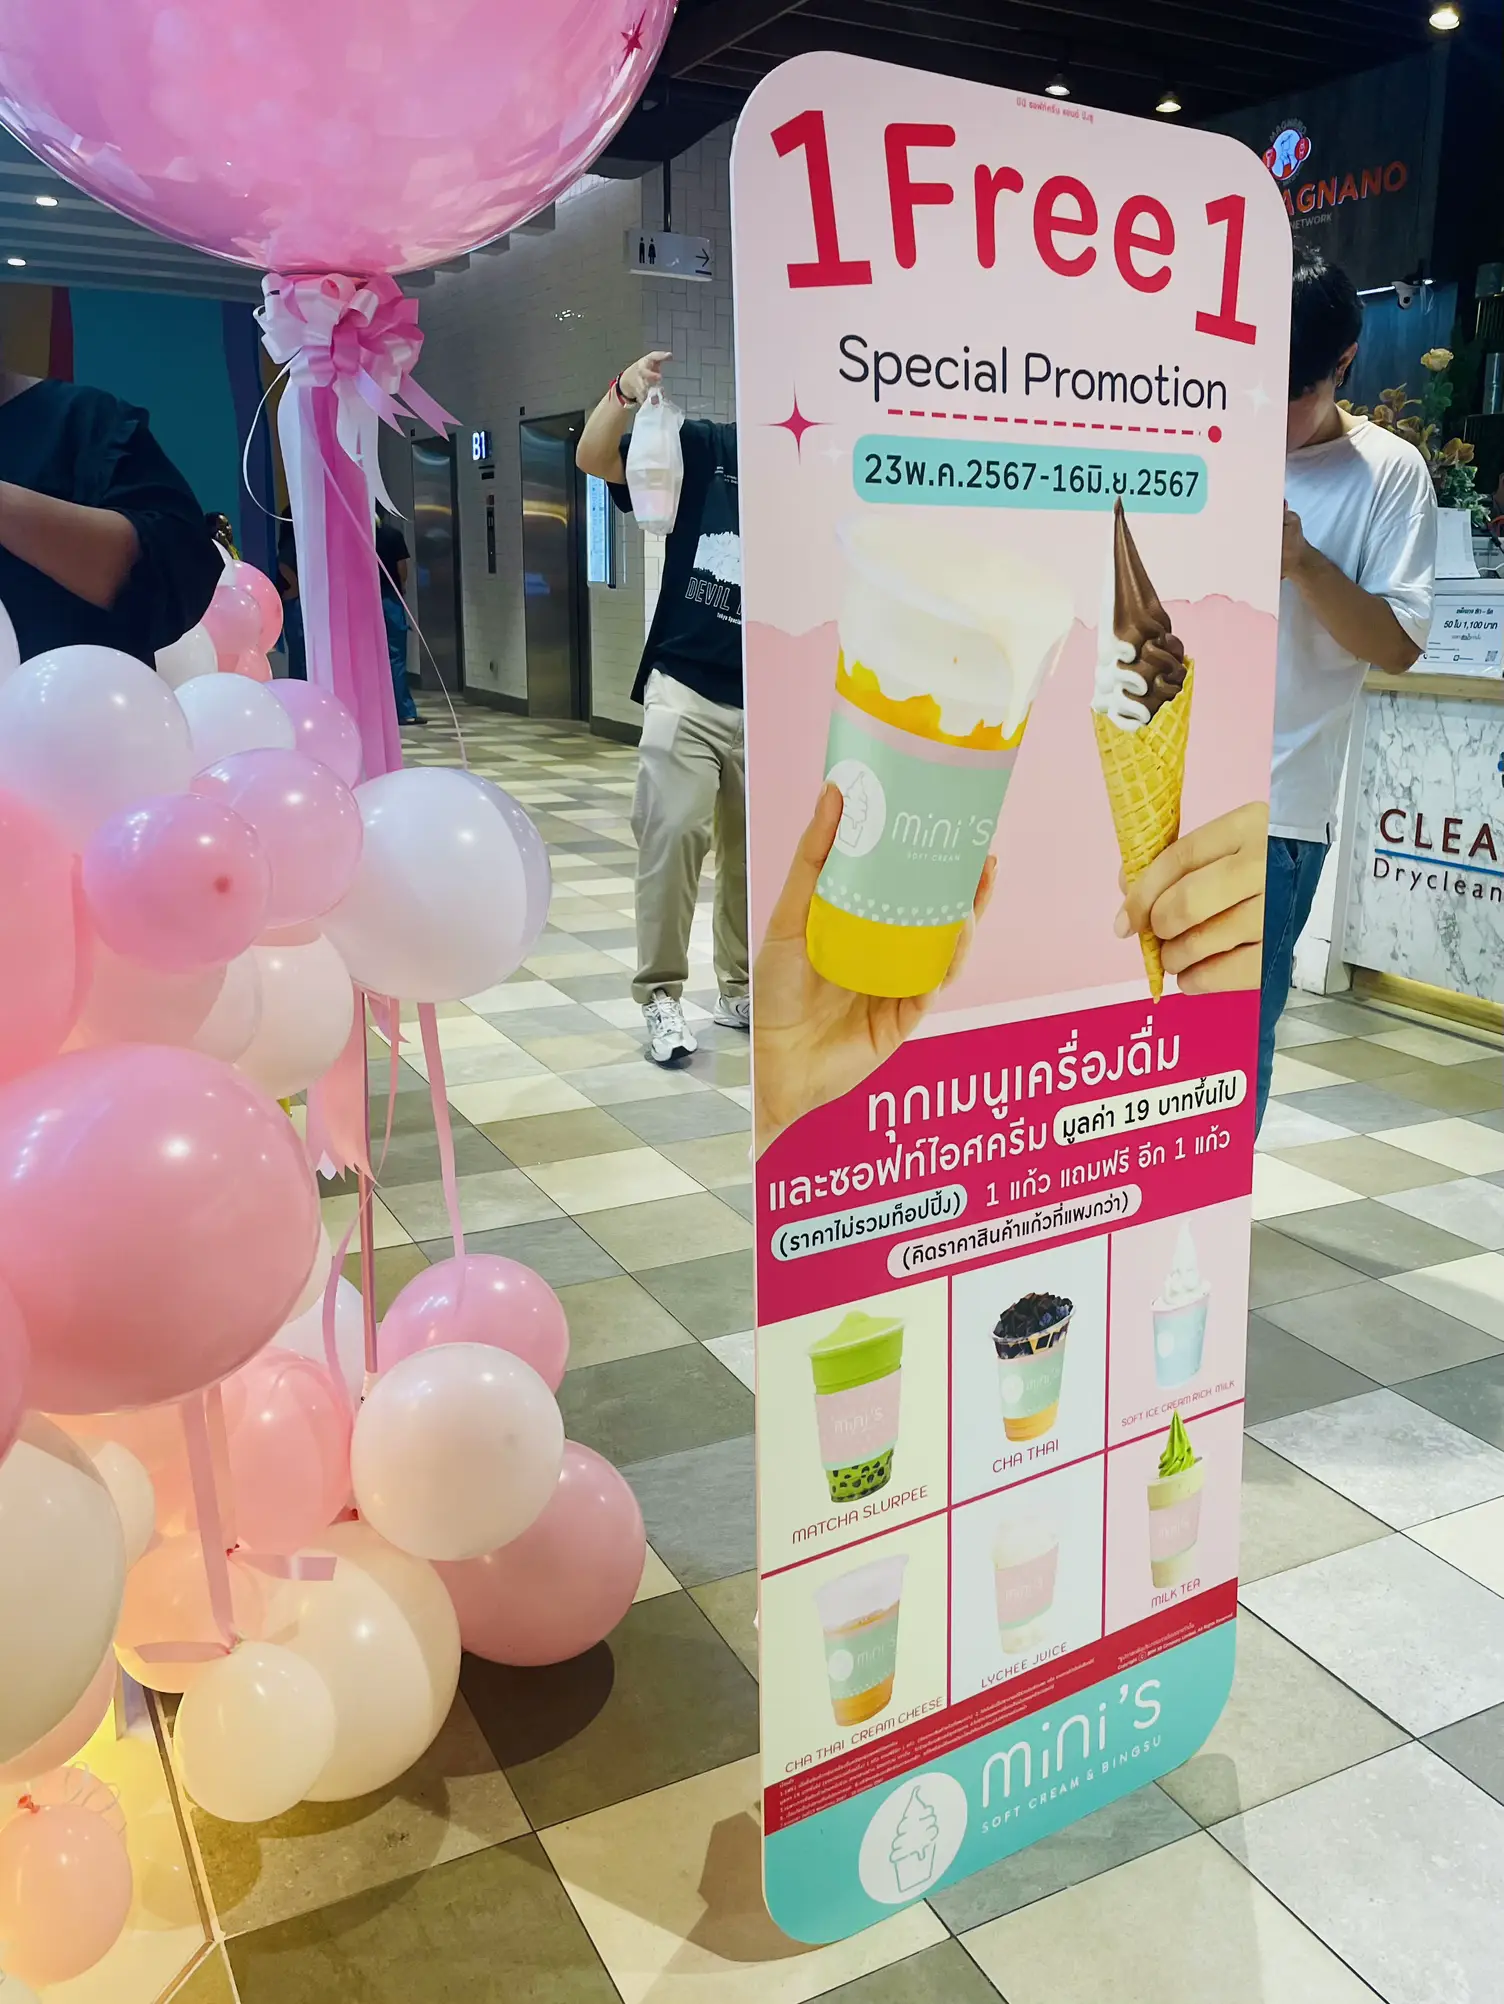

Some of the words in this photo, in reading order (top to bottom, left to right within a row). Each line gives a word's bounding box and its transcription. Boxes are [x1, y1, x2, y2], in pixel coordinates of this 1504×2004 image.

[839, 334, 1007, 402] Special
[1024, 351, 1228, 410] Promotion
[472, 430, 487, 461] B1
[685, 576, 731, 612] DEVIL
[1443, 620, 1453, 629] 50
[1463, 620, 1483, 630] 1,100
[1380, 808, 1498, 861] CLEA
[1373, 857, 1502, 903] Dryclean
[868, 1015, 1181, 1144] ทุกเมนูเครื่องดื่ม
[769, 1116, 1047, 1211] และซอฟท์ไอศครีม
[1063, 1104, 1115, 1145] มูลค่า
[1124, 1099, 1149, 1124] 19
[1158, 1076, 1237, 1117] บาทขึ้นไป
[986, 1182, 1000, 1207] 1
[1010, 1168, 1051, 1201] แก้ว
[1060, 1147, 1130, 1189] แถมฟรี
[1138, 1142, 1166, 1169] อีก
[1174, 1137, 1186, 1160] 1
[1194, 1124, 1231, 1155] แก้ว
[780, 1190, 960, 1257] (ราคาไม่รวมท็อปปิ้ง)
[902, 1191, 1128, 1270] (คิดราคาสินค้าแก้วที่แพงกว่า)
[1121, 1409, 1143, 1427] SOFT
[1145, 1405, 1160, 1419] ICE
[1161, 1395, 1191, 1413] CREAM
[1192, 1387, 1212, 1402] RICH
[992, 1452, 1023, 1473] CHA
[1027, 1439, 1059, 1461] THAI
[792, 1510, 859, 1544] MATCHA
[863, 1485, 928, 1519] SLURPEE
[1151, 1588, 1178, 1608] MILK
[1180, 1578, 1201, 1595] TEA
[981, 1659, 1028, 1689] LYCHEE
[1032, 1641, 1067, 1665] JUICE
[785, 1754, 812, 1773] CHA
[816, 1740, 845, 1760] THAI
[851, 1717, 896, 1745] CREAM
[898, 1696, 943, 1724] CHEESE
[982, 1679, 1161, 1808] mini's
[981, 1805, 1021, 1834] SOFT
[1028, 1776, 1080, 1810] CREAM
[1086, 1768, 1095, 1781] &
[1101, 1735, 1161, 1774] BINGSU
